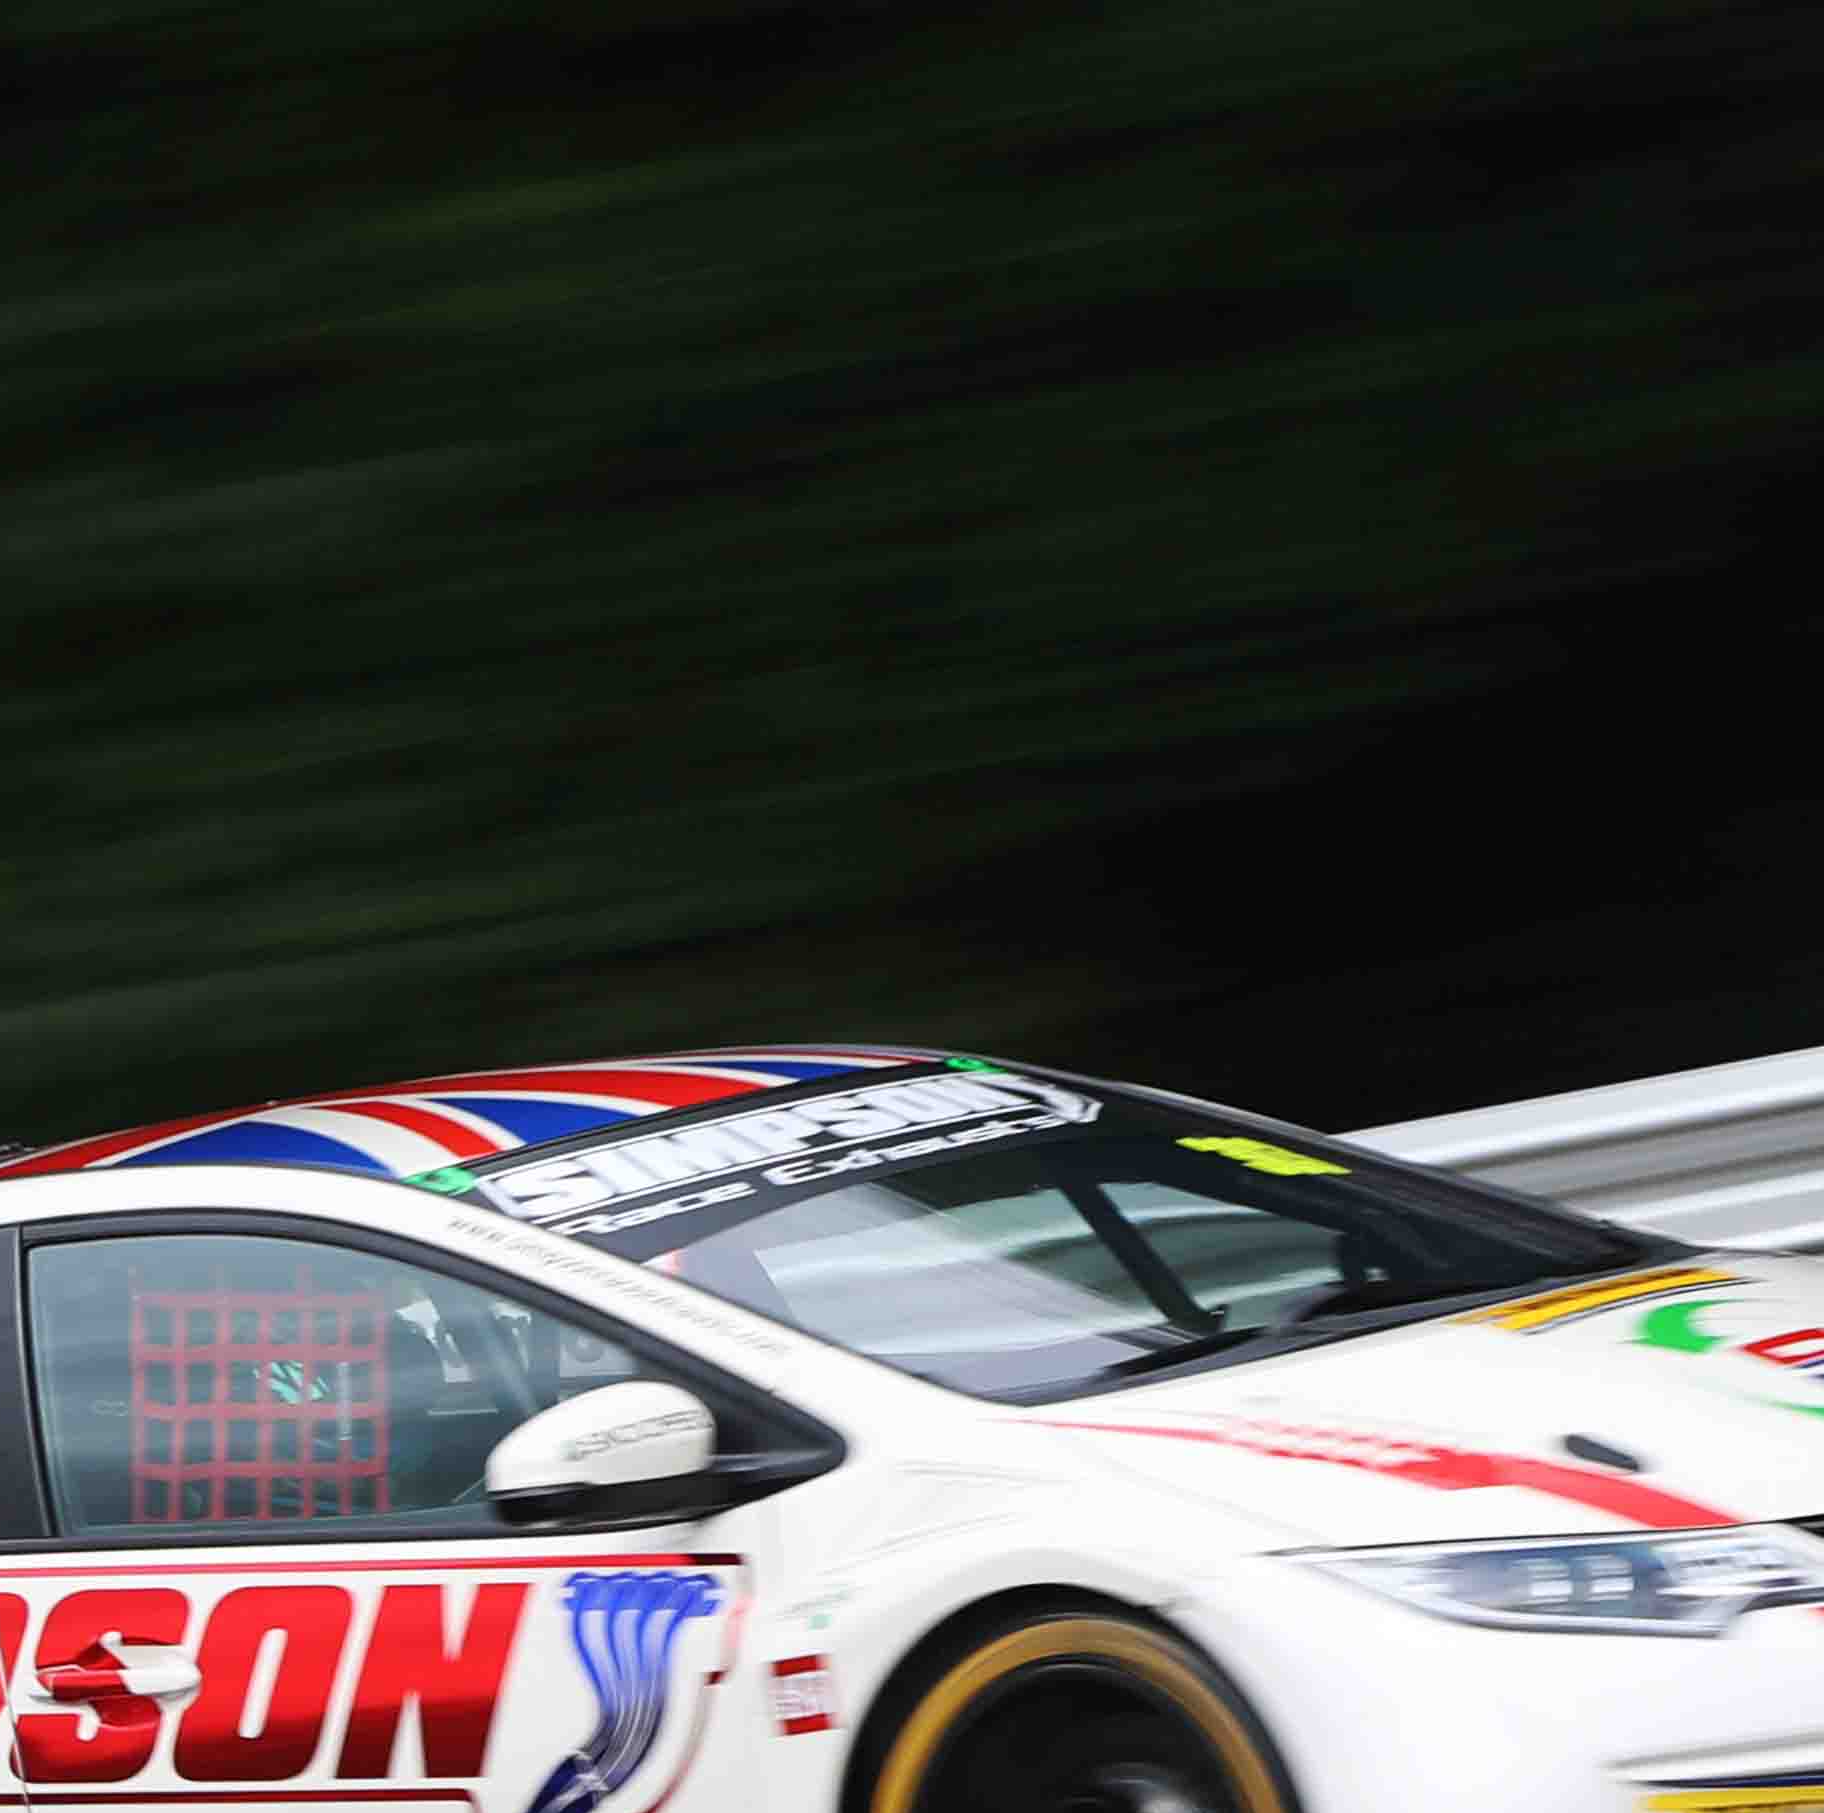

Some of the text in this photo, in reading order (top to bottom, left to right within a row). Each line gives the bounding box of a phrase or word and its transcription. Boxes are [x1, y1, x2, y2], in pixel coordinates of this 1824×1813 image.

[494, 1073, 1032, 1217] SIMPSON
[548, 1114, 1068, 1235] Race Exhausts
